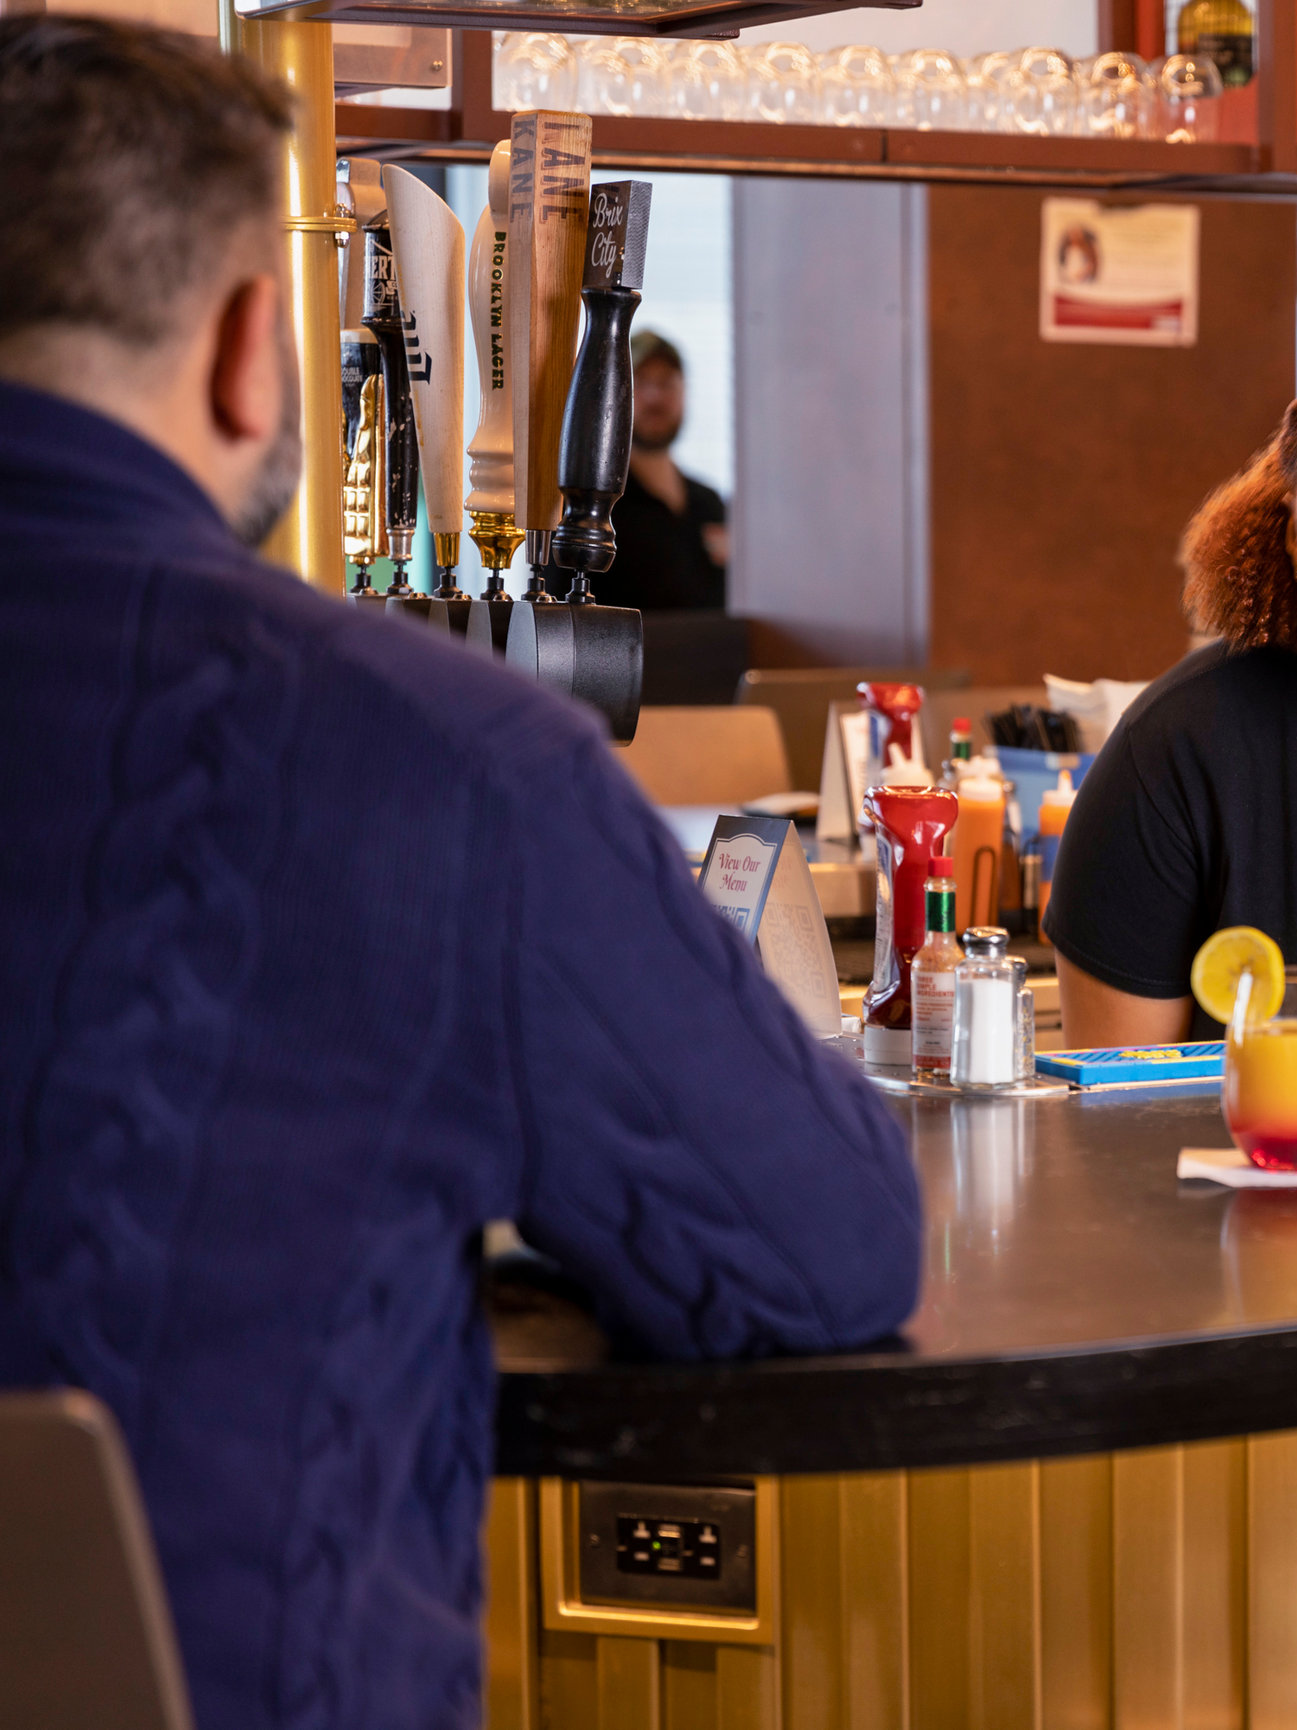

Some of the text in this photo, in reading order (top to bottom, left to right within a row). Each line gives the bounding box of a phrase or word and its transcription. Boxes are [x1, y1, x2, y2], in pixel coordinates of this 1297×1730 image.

[510, 119, 535, 224] KANE
[592, 192, 624, 228] Brix
[591, 230, 617, 278] City
[491, 231, 507, 391] BROOKLYN LAGER
[719, 853, 761, 873] View Our
[720, 871, 748, 893] Menu
